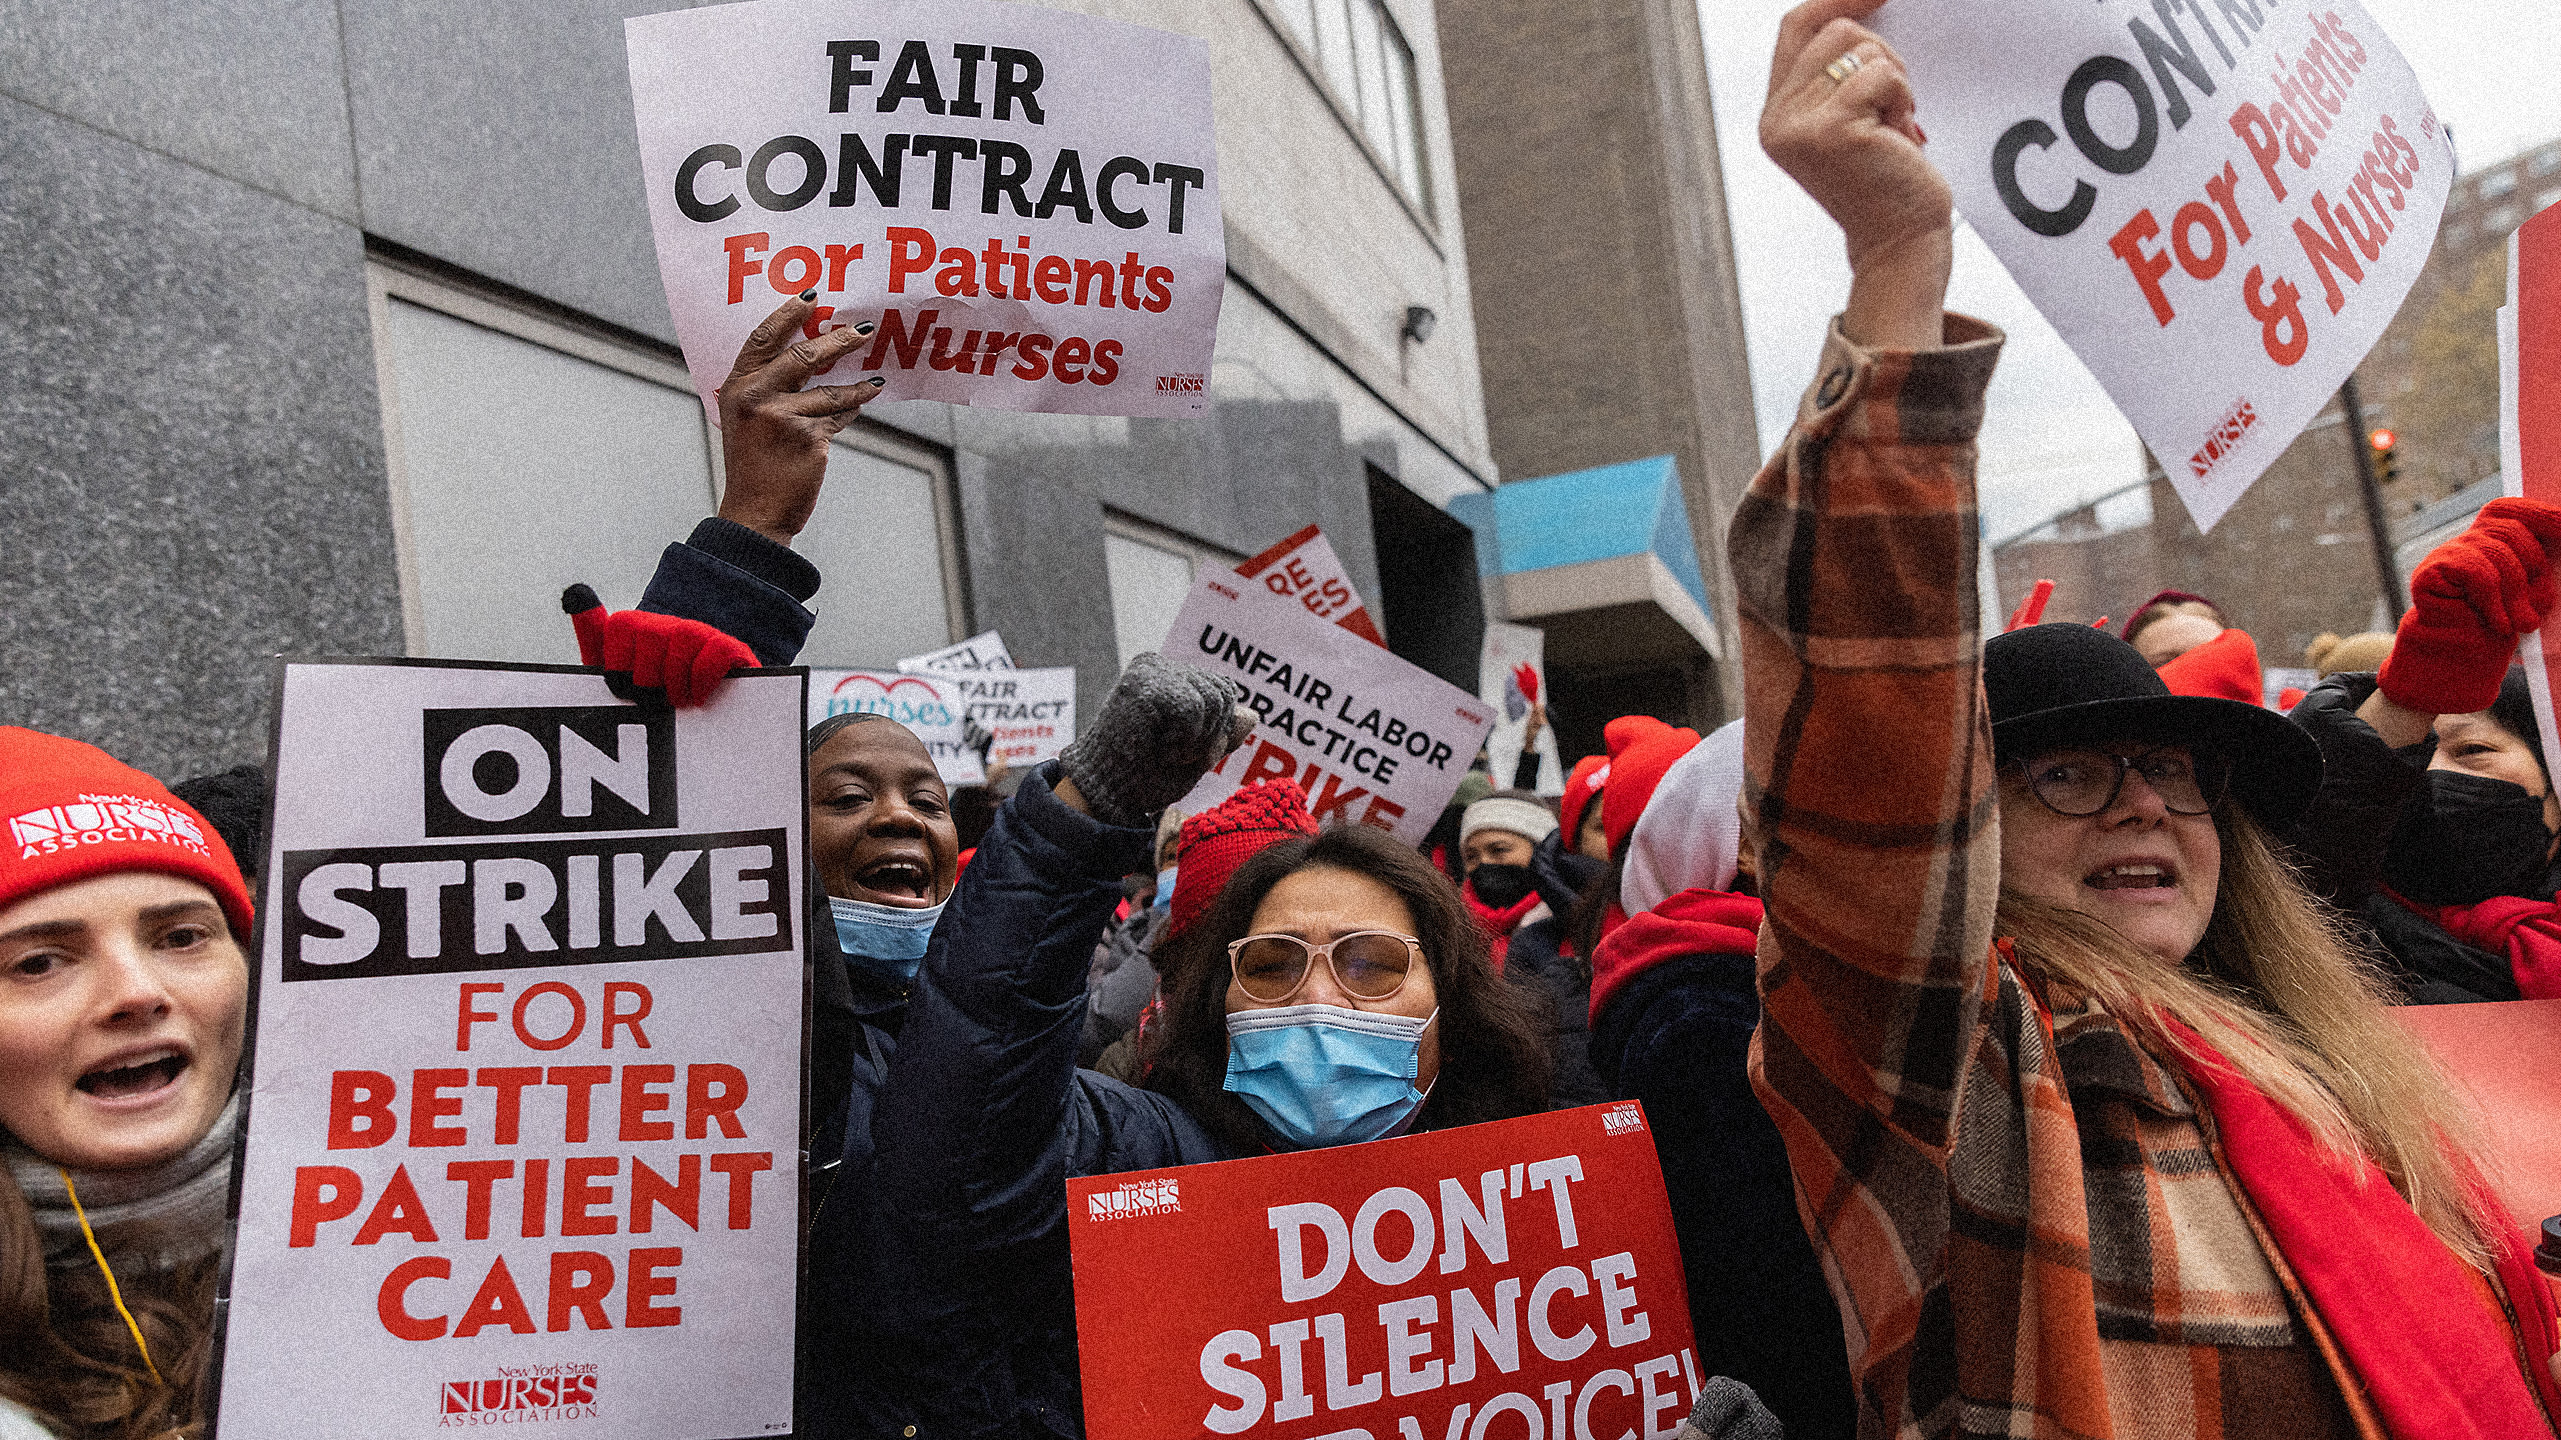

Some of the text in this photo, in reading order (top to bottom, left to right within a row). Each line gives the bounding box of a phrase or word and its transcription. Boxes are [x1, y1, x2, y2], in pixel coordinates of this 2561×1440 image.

[826, 40, 1045, 125] FAIR
[674, 133, 1204, 234] CONTRACT
[2107, 160, 2252, 328] For
[2229, 11, 2367, 203] Patients
[723, 226, 1174, 313] For Patients
[2243, 113, 2419, 366] & Nurses
[862, 308, 1124, 386] Nurses
[1156, 376, 1204, 391] NURSES
[1199, 624, 1453, 771] UNFAIR LABOR
[440, 724, 650, 822] ON
[298, 845, 778, 965] STRIKE
[456, 981, 652, 1052] FOR
[327, 1063, 749, 1150] BETTER
[1601, 1110, 1641, 1131] NURSES
[1606, 1124, 1645, 1136] ASSOCIATION
[289, 1152, 773, 1248] PATIENT
[1088, 1185, 1180, 1215] NURSES
[1090, 1202, 1183, 1223] ASSOCIATION
[1119, 1183, 1138, 1191] New
[1139, 1179, 1157, 1189] York
[1267, 1154, 1584, 1304] DON'T
[378, 1247, 683, 1342] CARE
[498, 1362, 598, 1378] New York State
[1200, 1251, 1651, 1434] SILENCE
[439, 1406, 600, 1428] ASSOCIATION
[440, 1374, 599, 1414] NURSES
